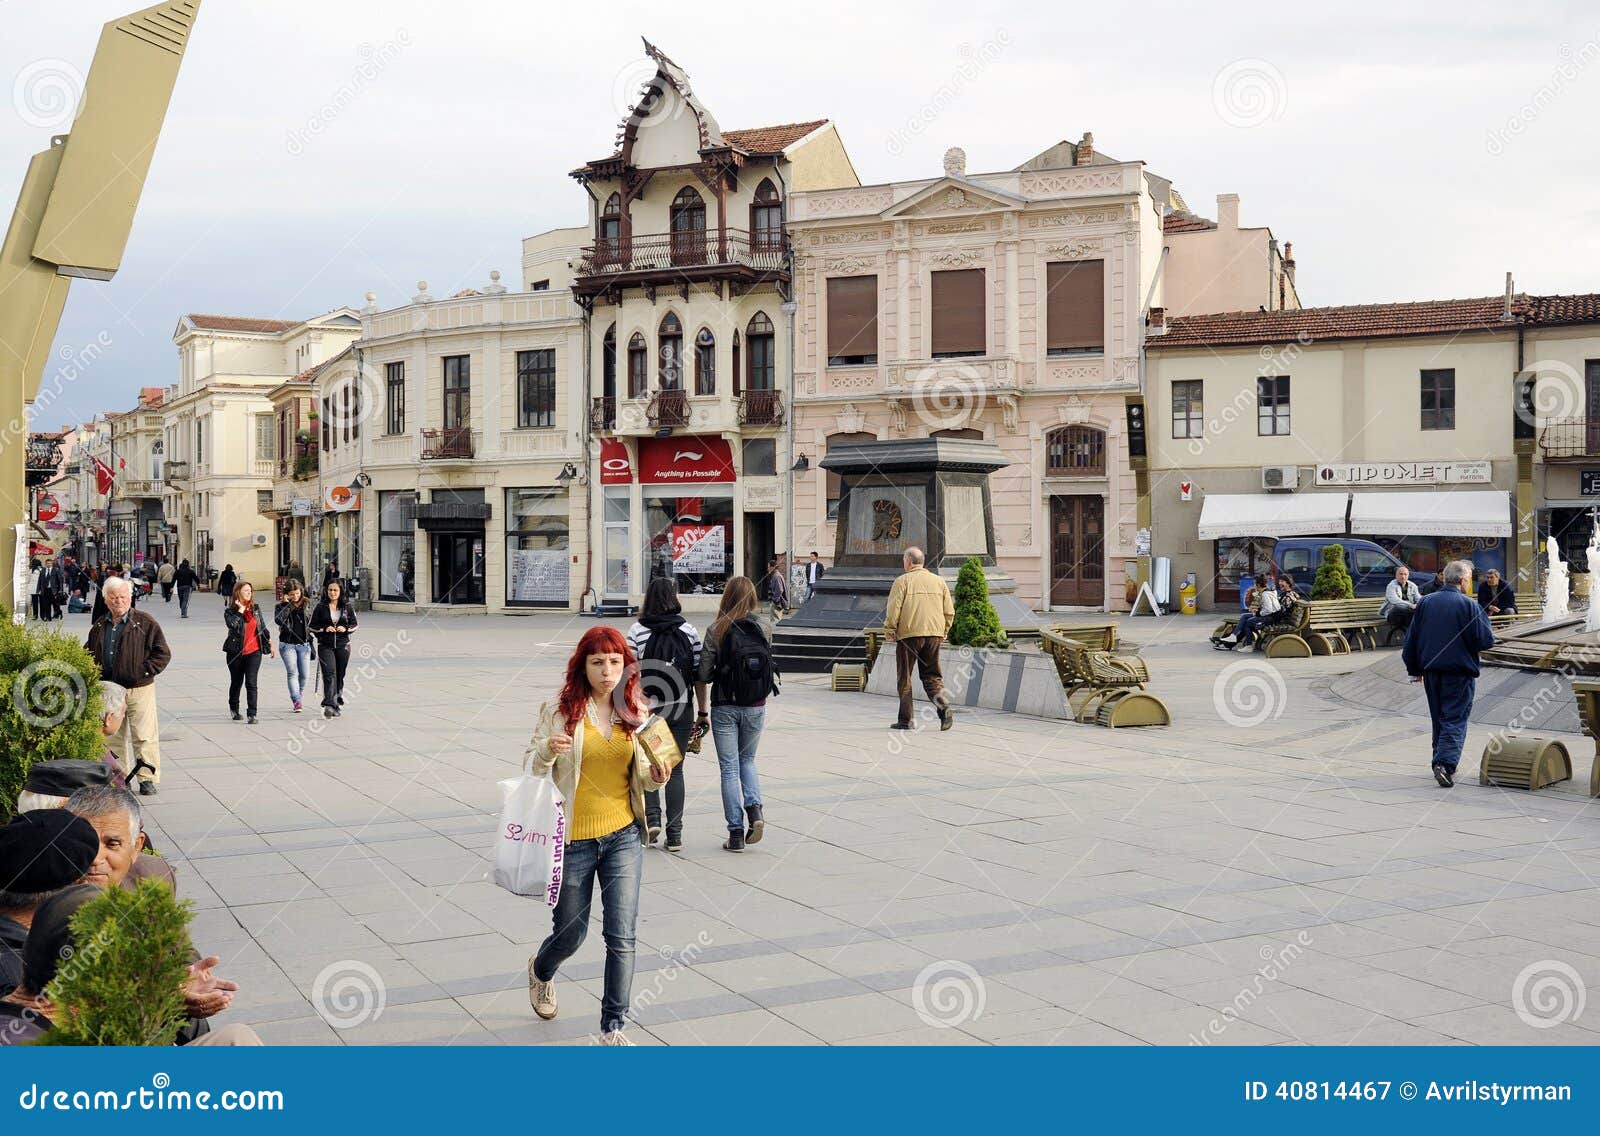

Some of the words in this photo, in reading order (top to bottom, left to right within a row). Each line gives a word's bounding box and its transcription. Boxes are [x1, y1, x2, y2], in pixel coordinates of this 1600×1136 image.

[654, 469, 684, 479] Anything
[692, 469, 722, 478] Possible
[1346, 463, 1452, 483] ПРОМЕТ
